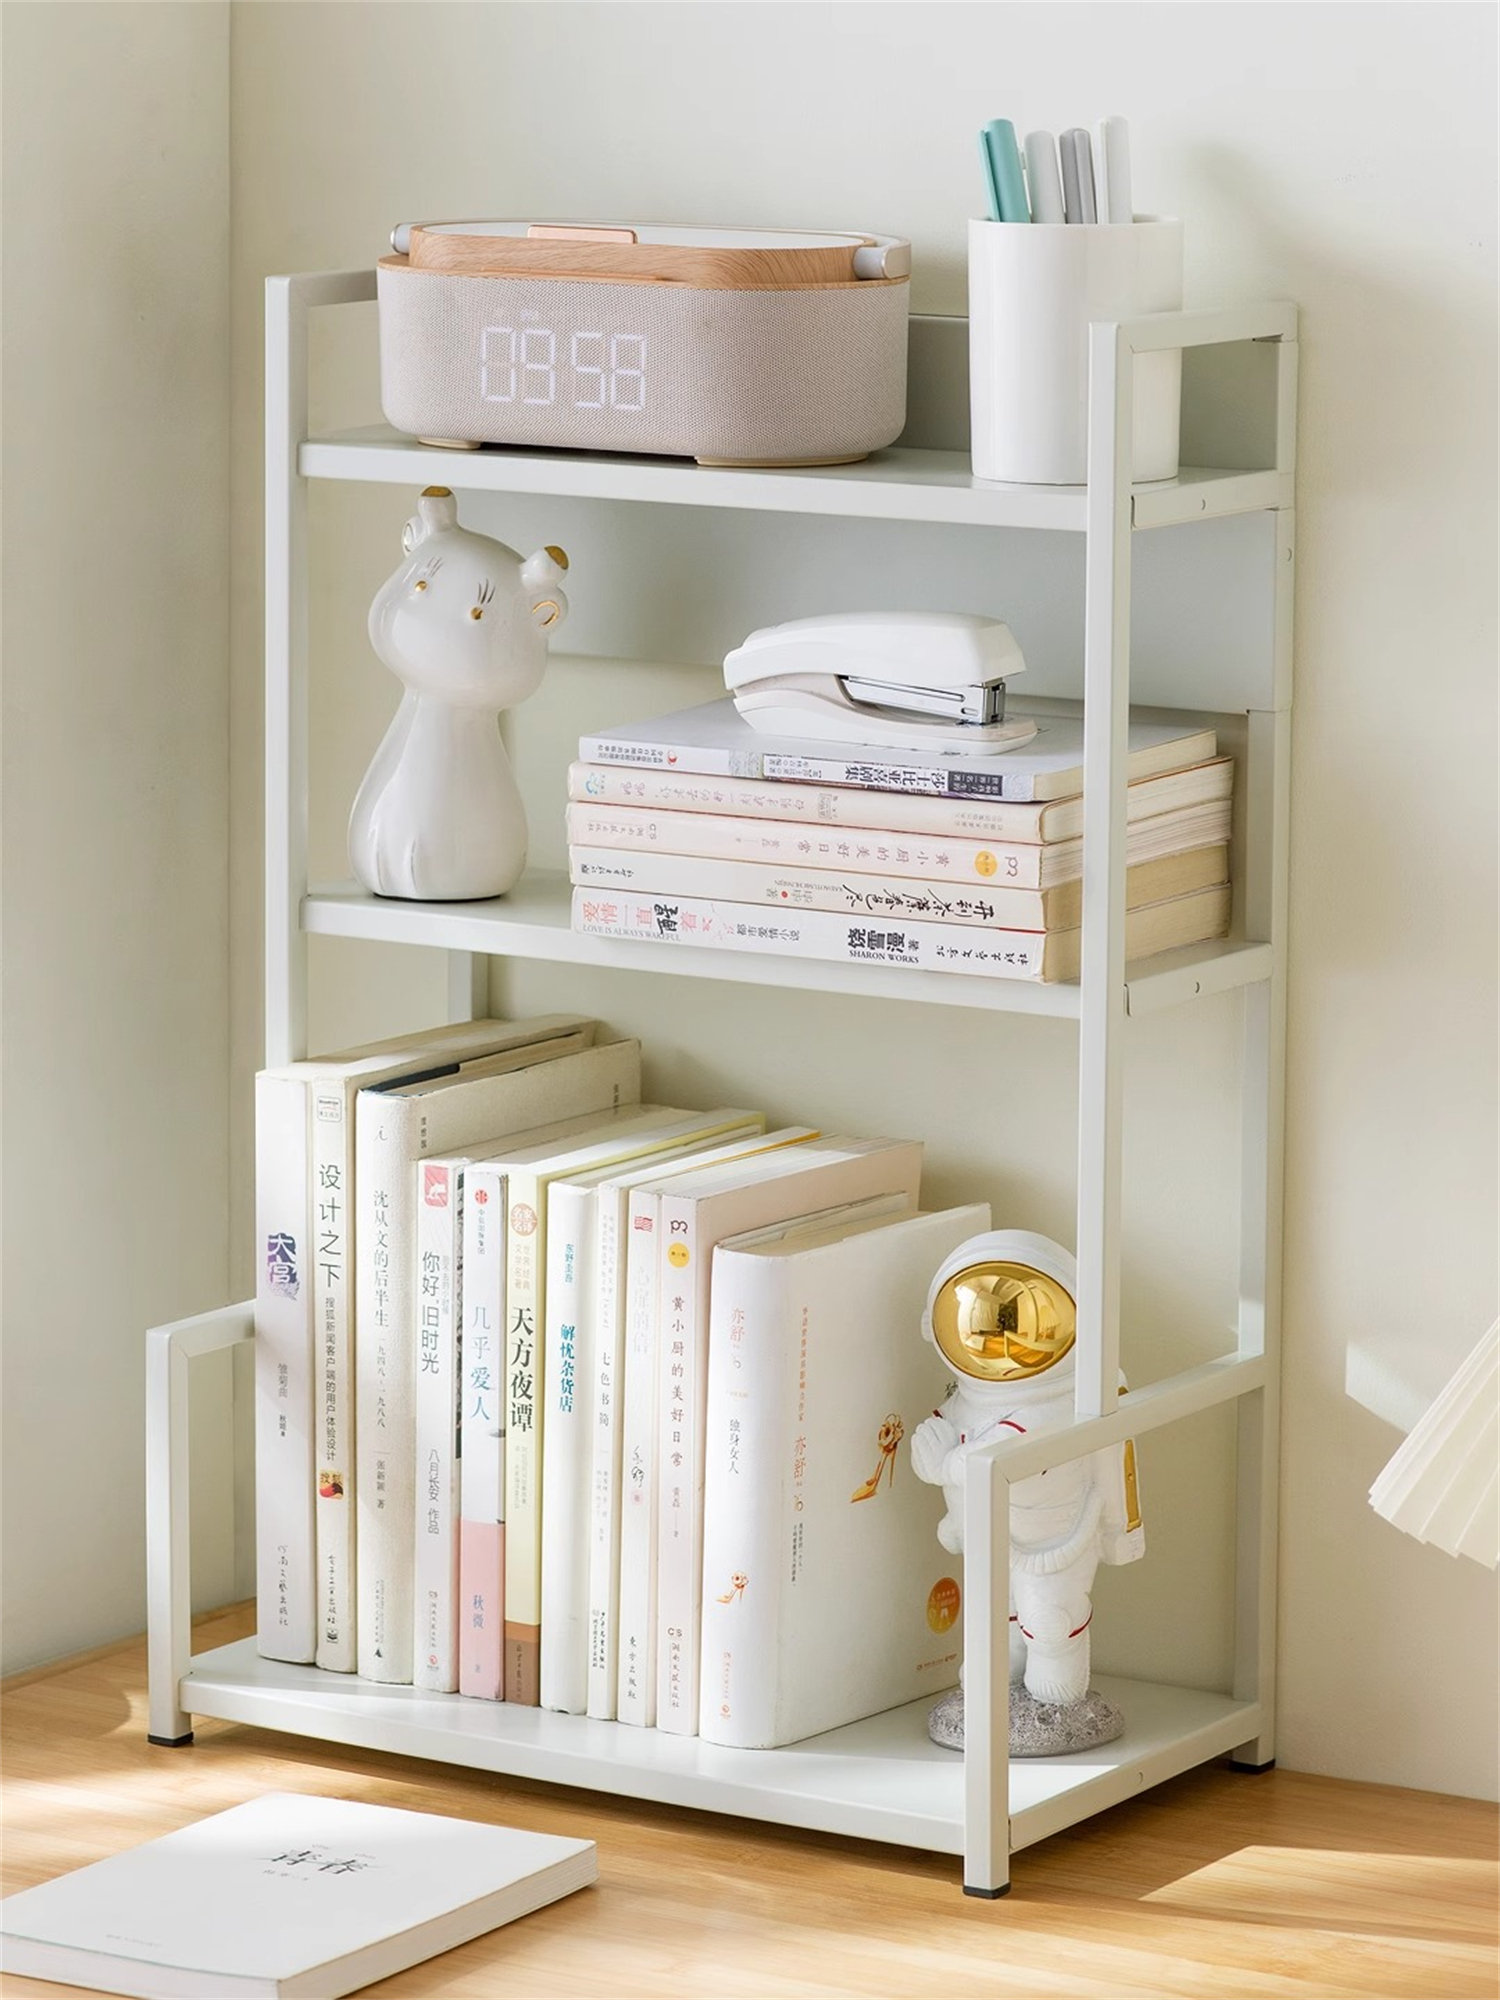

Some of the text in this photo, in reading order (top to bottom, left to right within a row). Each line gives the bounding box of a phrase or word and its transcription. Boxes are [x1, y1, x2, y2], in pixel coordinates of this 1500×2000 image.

[845, 765, 946, 792] 莎士比亚喜剧集
[797, 839, 950, 867] 黄小厨的美好日常
[582, 924, 681, 943] LOVE IS ALWAYS WAKEFUL
[736, 923, 801, 942] 都市爱情小说
[847, 928, 906, 953] 饶雪漫
[849, 949, 920, 964] SHARON WORKS
[318, 1163, 342, 1289] 设计之下
[373, 1189, 389, 1328] 沈从文的后半生
[564, 1243, 575, 1284] 东野圭吾
[730, 1307, 745, 1343] 亦舒
[324, 1297, 338, 1462] 搜狐新闻客户端的用户体验设计
[469, 1306, 493, 1421] 几乎爱人
[510, 1307, 534, 1433] 天方夜谭
[559, 1324, 576, 1413] 解忧杂货店
[600, 1351, 611, 1427] 七色书简
[670, 1296, 685, 1468] 黄小厨的美好日常
[427, 1448, 440, 1535] 八月长安 作品
[667, 1627, 683, 1638] CS
